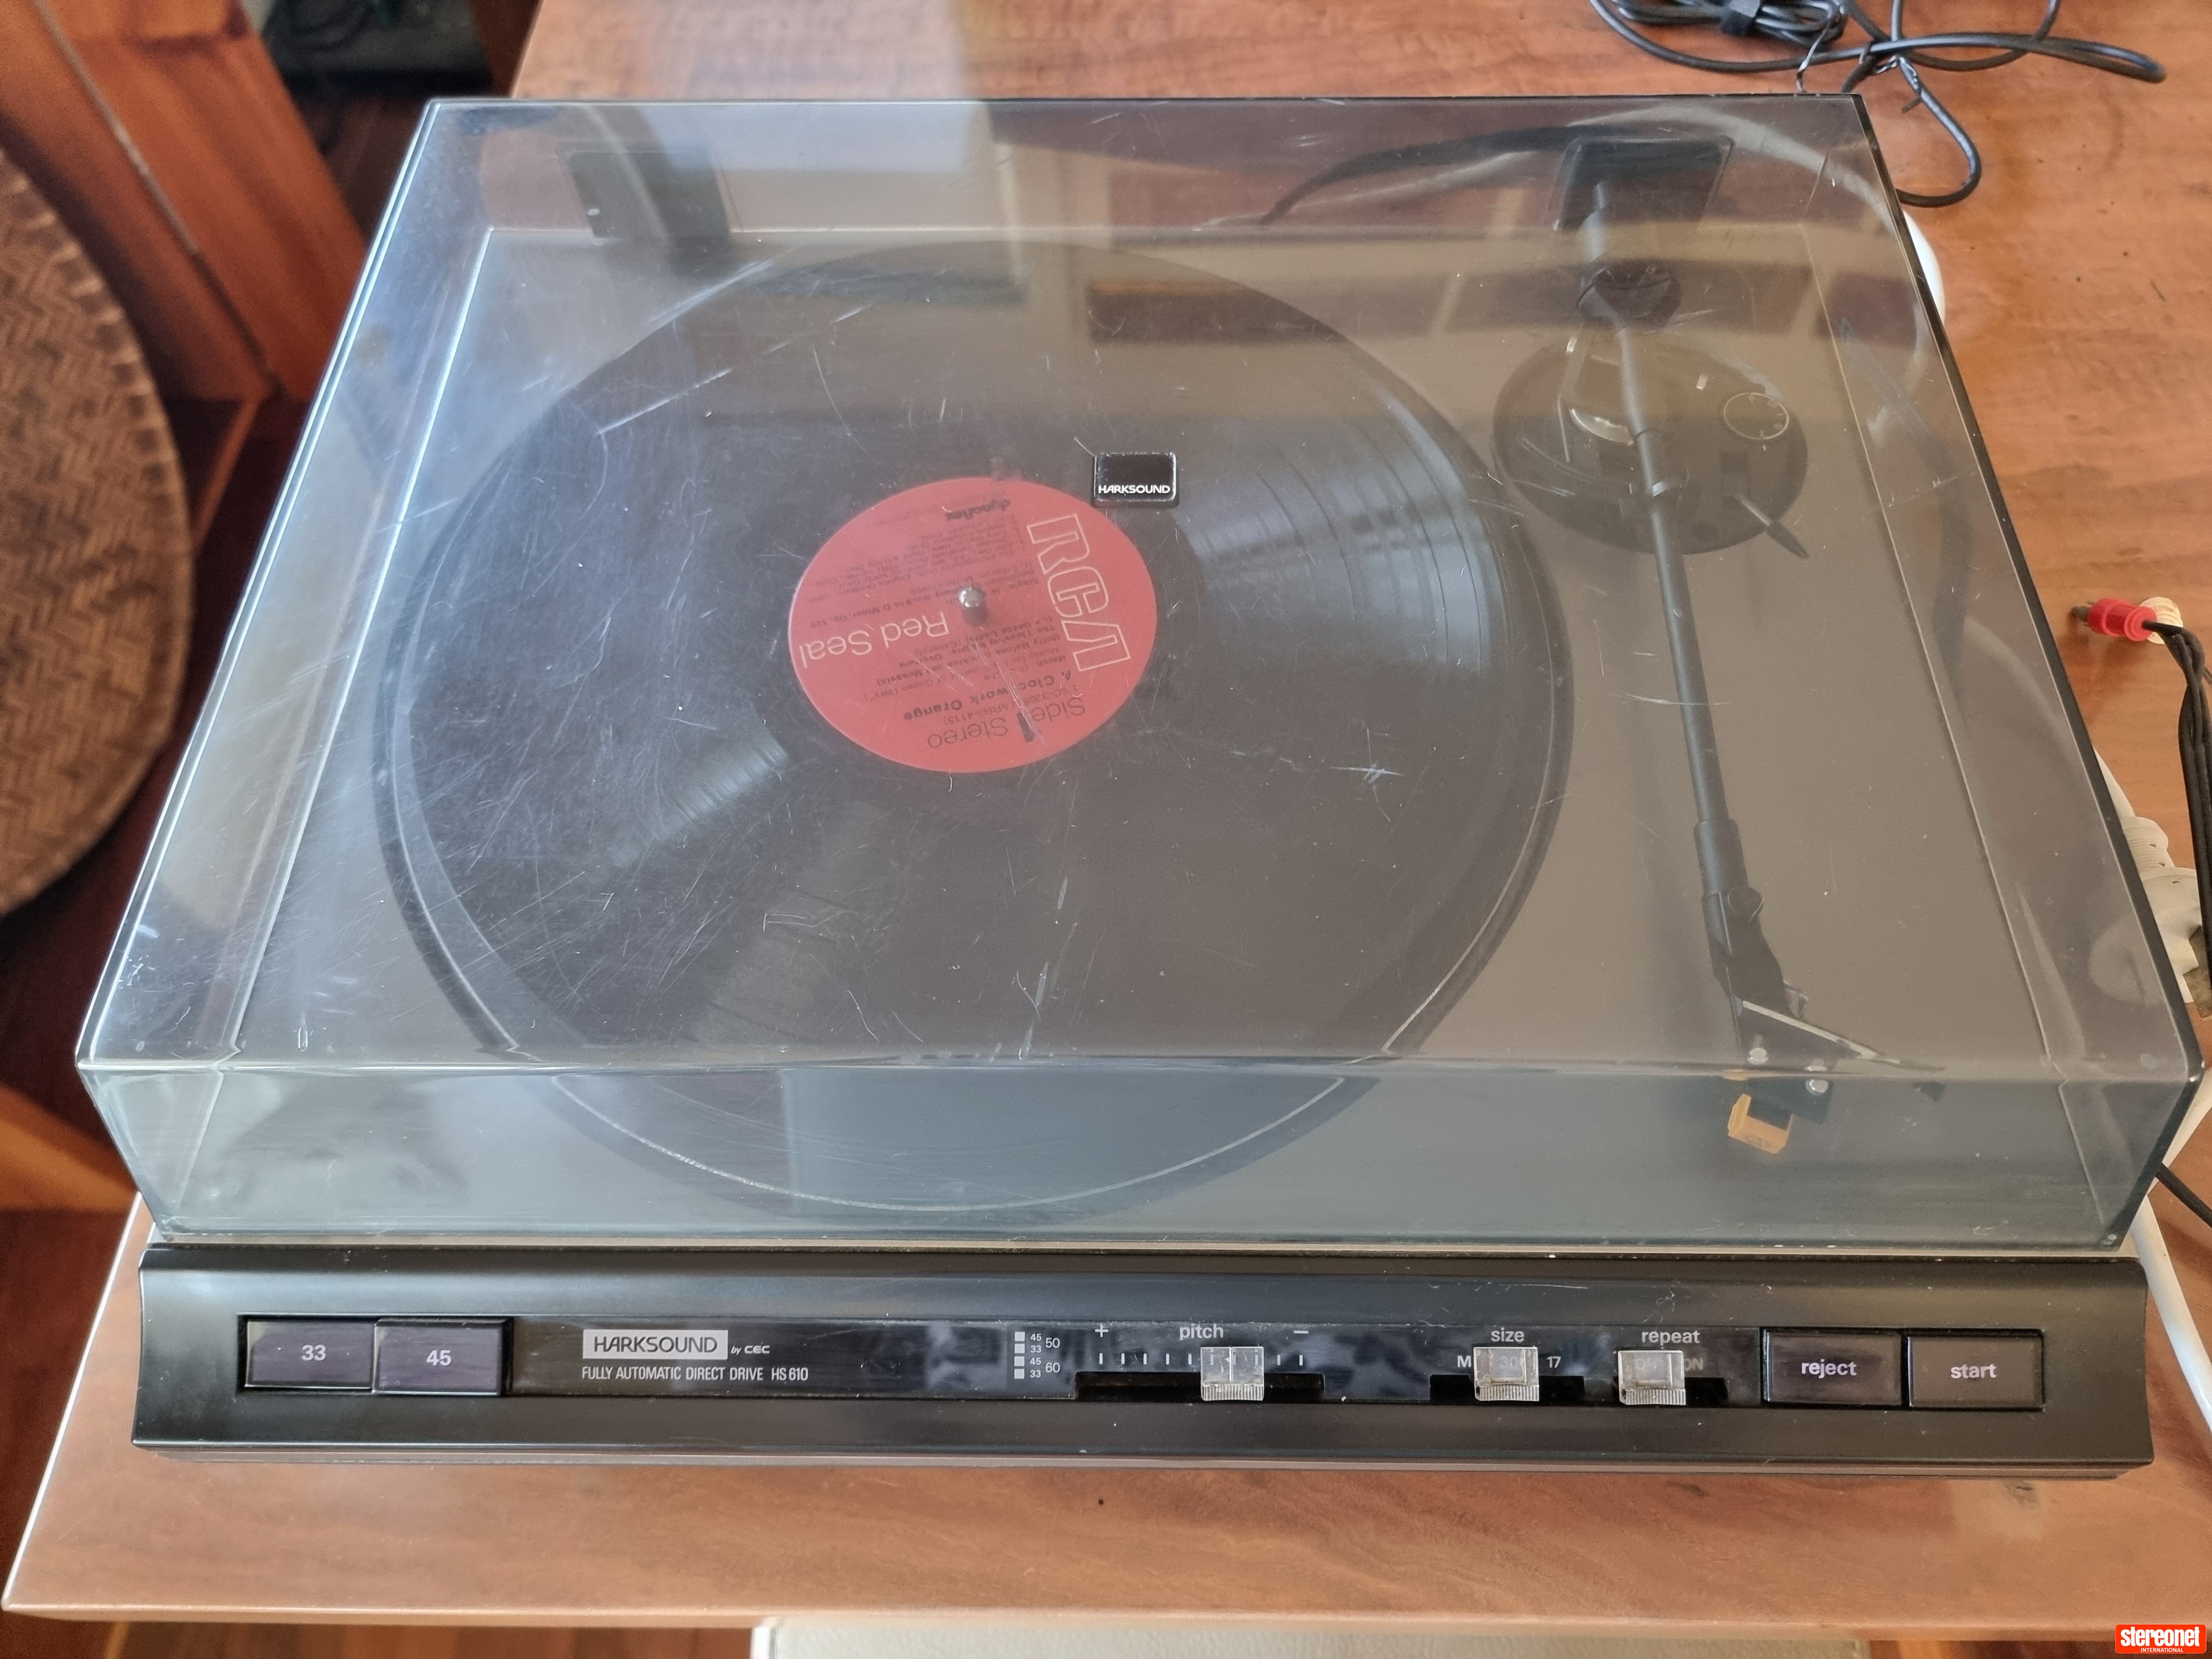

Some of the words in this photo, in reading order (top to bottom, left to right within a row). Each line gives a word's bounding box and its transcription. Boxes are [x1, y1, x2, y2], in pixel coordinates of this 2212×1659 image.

[1098, 484, 1171, 494] HARKSOUND
[1026, 513, 1131, 672] RCA
[880, 611, 950, 649] Red
[1033, 634, 1061, 645] Molly
[800, 630, 873, 668] Seal
[995, 642, 1030, 655] Malone
[1036, 654, 1066, 667] March
[1061, 671, 1071, 681] A
[968, 675, 1055, 705] Clocwork
[904, 699, 963, 721] Orange
[1030, 696, 1086, 723] Side
[927, 717, 1008, 748] Stereo
[1180, 1323, 1224, 1340] pitch
[1491, 1327, 1525, 1342] size
[1641, 1330, 1700, 1345] repeat
[594, 1336, 718, 1353] HARKSOUND
[731, 1345, 742, 1355] by
[744, 1345, 770, 1354] CEC
[1030, 1345, 1042, 1353] 33
[1045, 1338, 1061, 1348] 50
[301, 1344, 326, 1360] 33
[426, 1349, 452, 1366] 45
[1045, 1362, 1061, 1373] 60
[1457, 1355, 1472, 1368] M
[1547, 1356, 1561, 1368] 17
[1801, 1359, 1858, 1379] reject
[582, 1366, 613, 1379] FULLY
[615, 1366, 681, 1380] AUTOMATIC
[686, 1367, 726, 1380] DIRECT
[730, 1367, 764, 1381] DRIVE
[1030, 1370, 1041, 1378] 33
[1950, 1364, 1997, 1379] start
